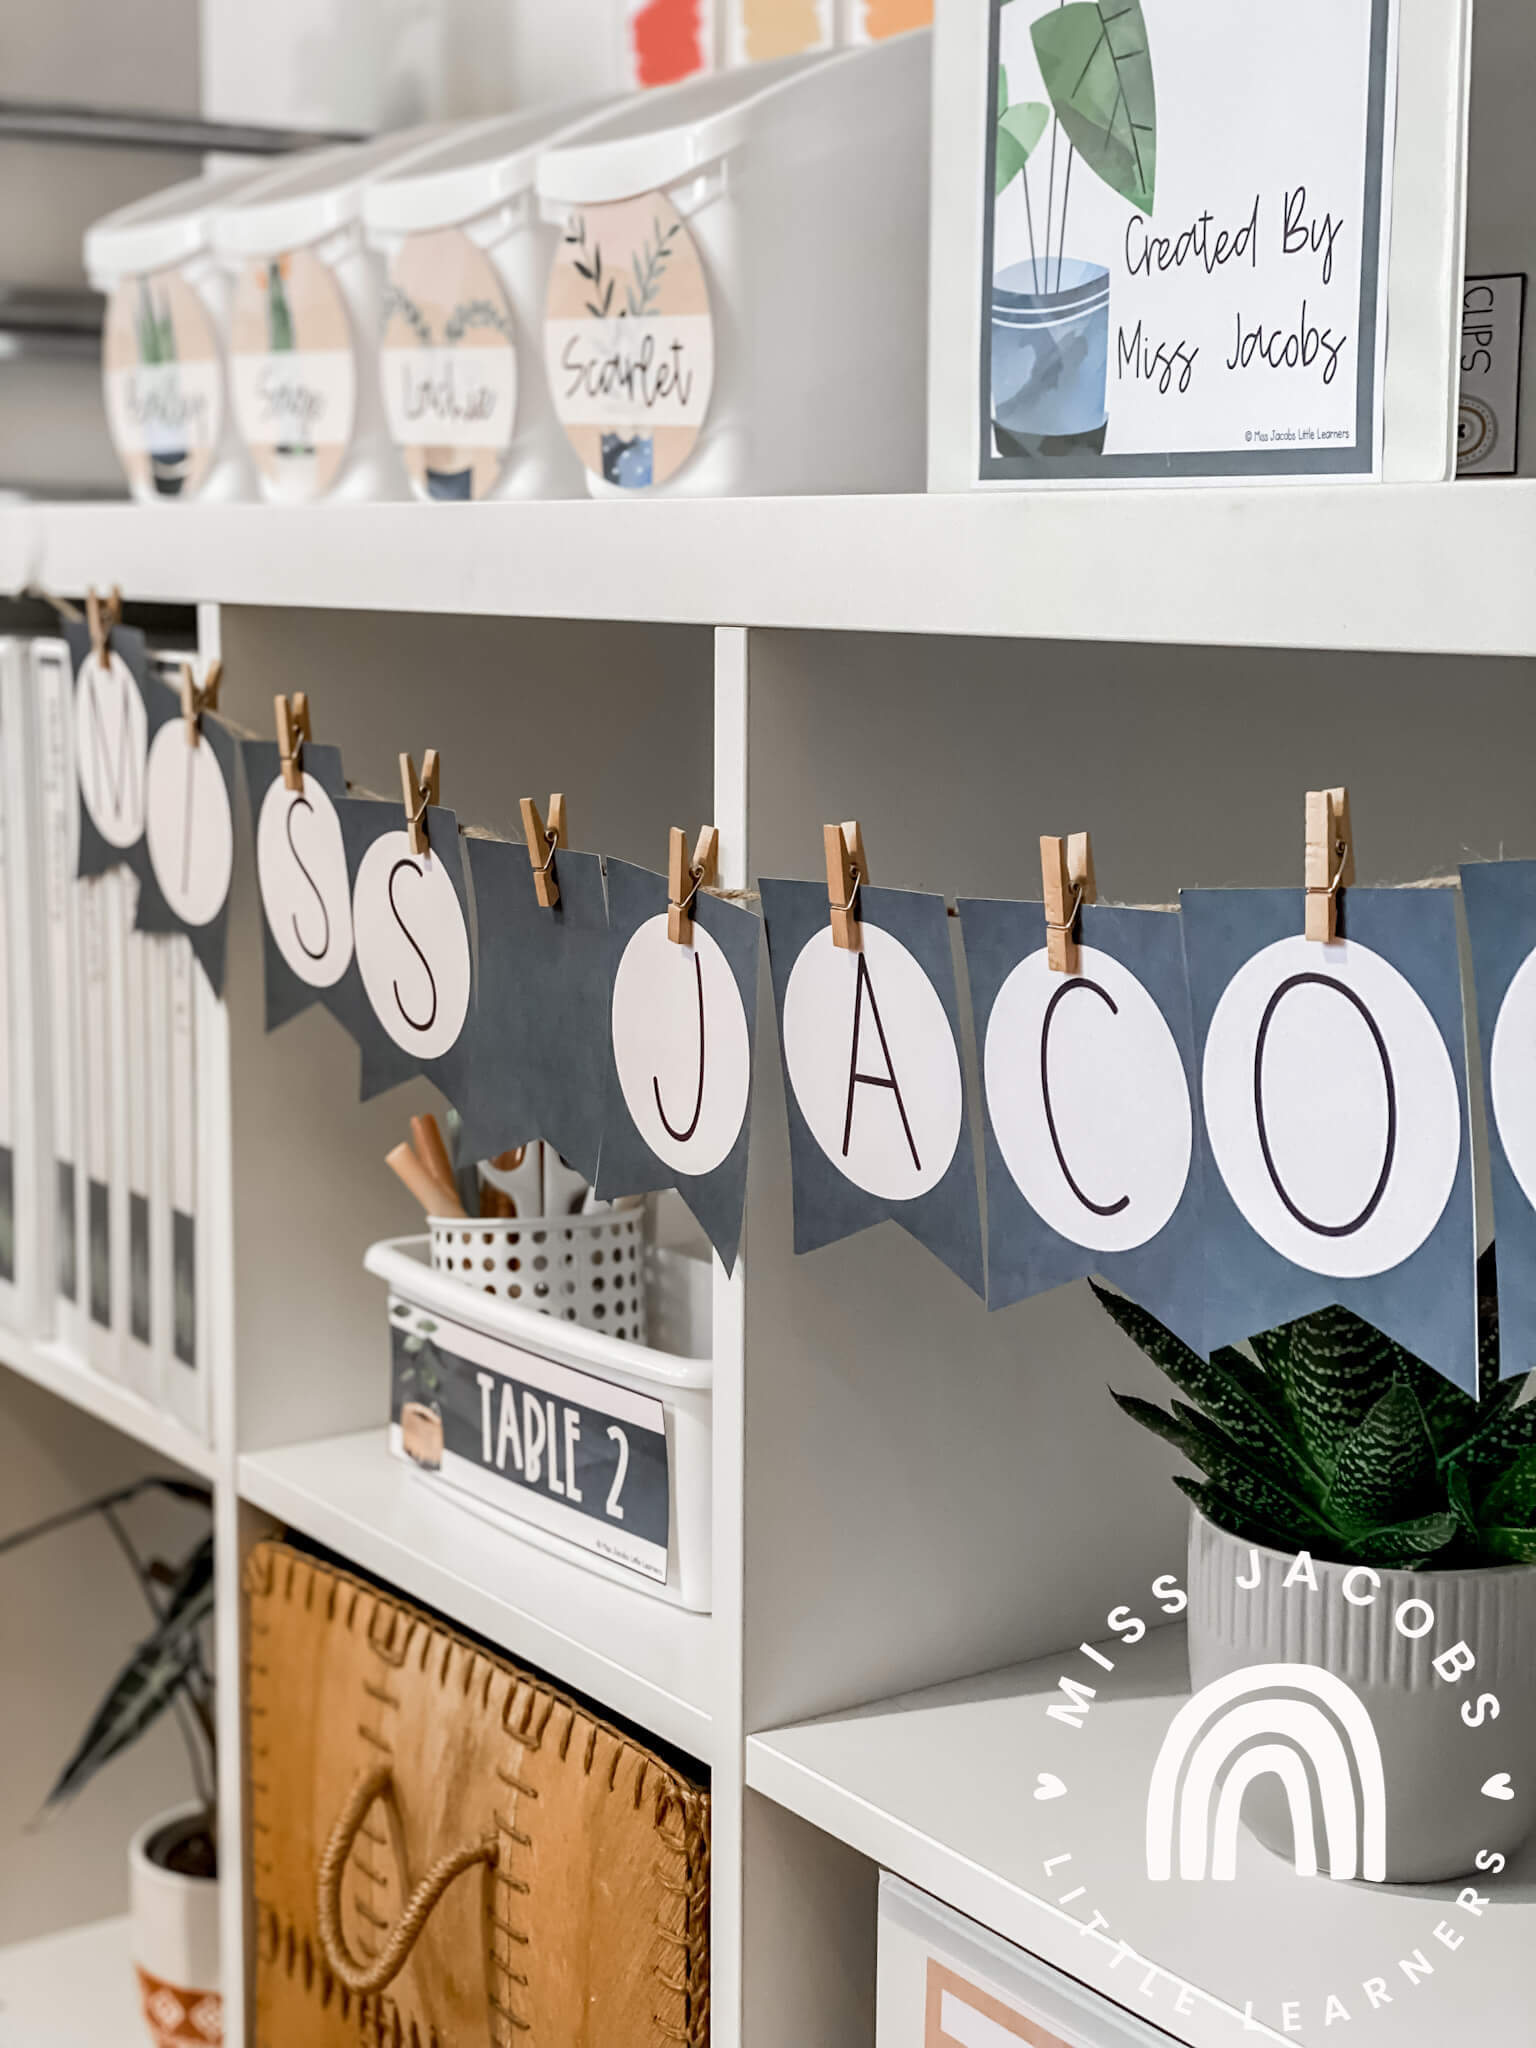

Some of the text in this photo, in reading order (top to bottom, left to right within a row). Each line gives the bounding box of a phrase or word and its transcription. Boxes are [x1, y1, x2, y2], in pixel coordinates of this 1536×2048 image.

[1124, 186, 1344, 285] Created By
[562, 334, 693, 407] Scarlet
[1117, 300, 1347, 394] Miss Jacobs
[1461, 286, 1494, 374] CLIPS
[1270, 426, 1297, 442] Jacobs
[1316, 426, 1350, 440] Learners
[476, 1371, 630, 1520] TABLE 2
